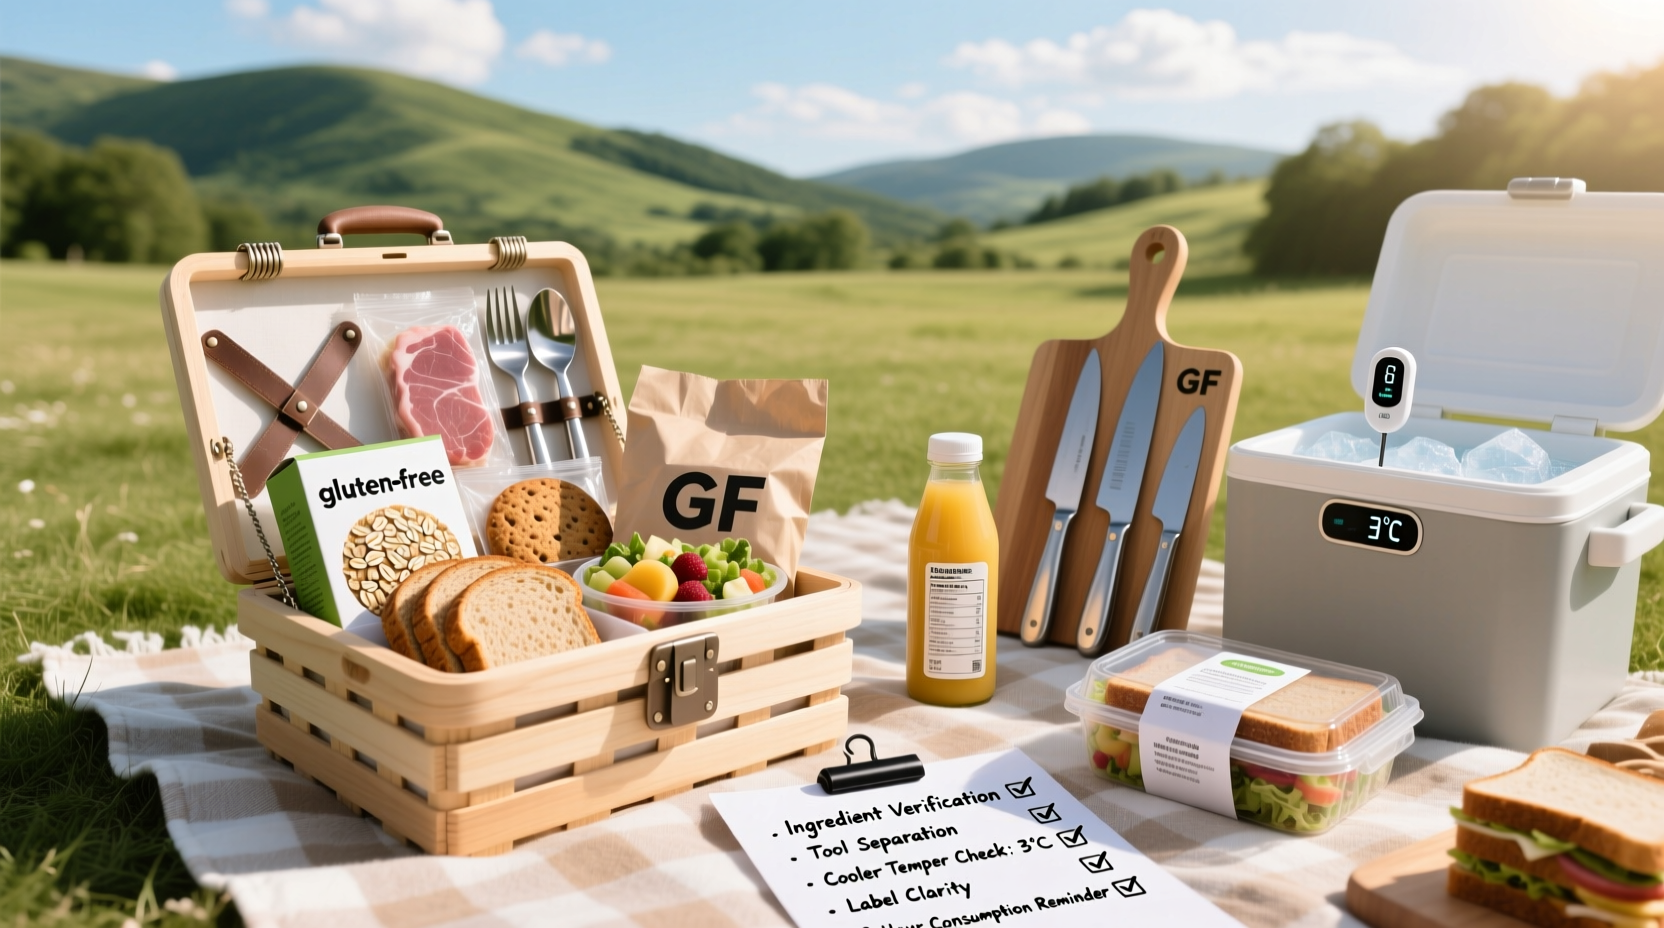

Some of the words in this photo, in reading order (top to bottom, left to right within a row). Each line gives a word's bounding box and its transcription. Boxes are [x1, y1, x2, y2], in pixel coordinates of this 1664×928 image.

[1176, 367, 1222, 396] GF
[318, 468, 446, 509] gluten-free
[662, 471, 767, 533] GF
[1367, 515, 1403, 543] 3°C
[785, 806, 883, 839] Ingredient
[888, 787, 1001, 818] Verification
[807, 839, 849, 860] Tool
[856, 824, 959, 853] Separation
[823, 865, 883, 888] Cooler
[885, 857, 949, 877] Temper
[954, 842, 1014, 864] Check:
[1017, 836, 1054, 853] 3°C
[846, 889, 899, 913] Label
[905, 881, 971, 902] Clarity
[929, 904, 1033, 928] Consumption
[1034, 886, 1110, 911] Reminder
